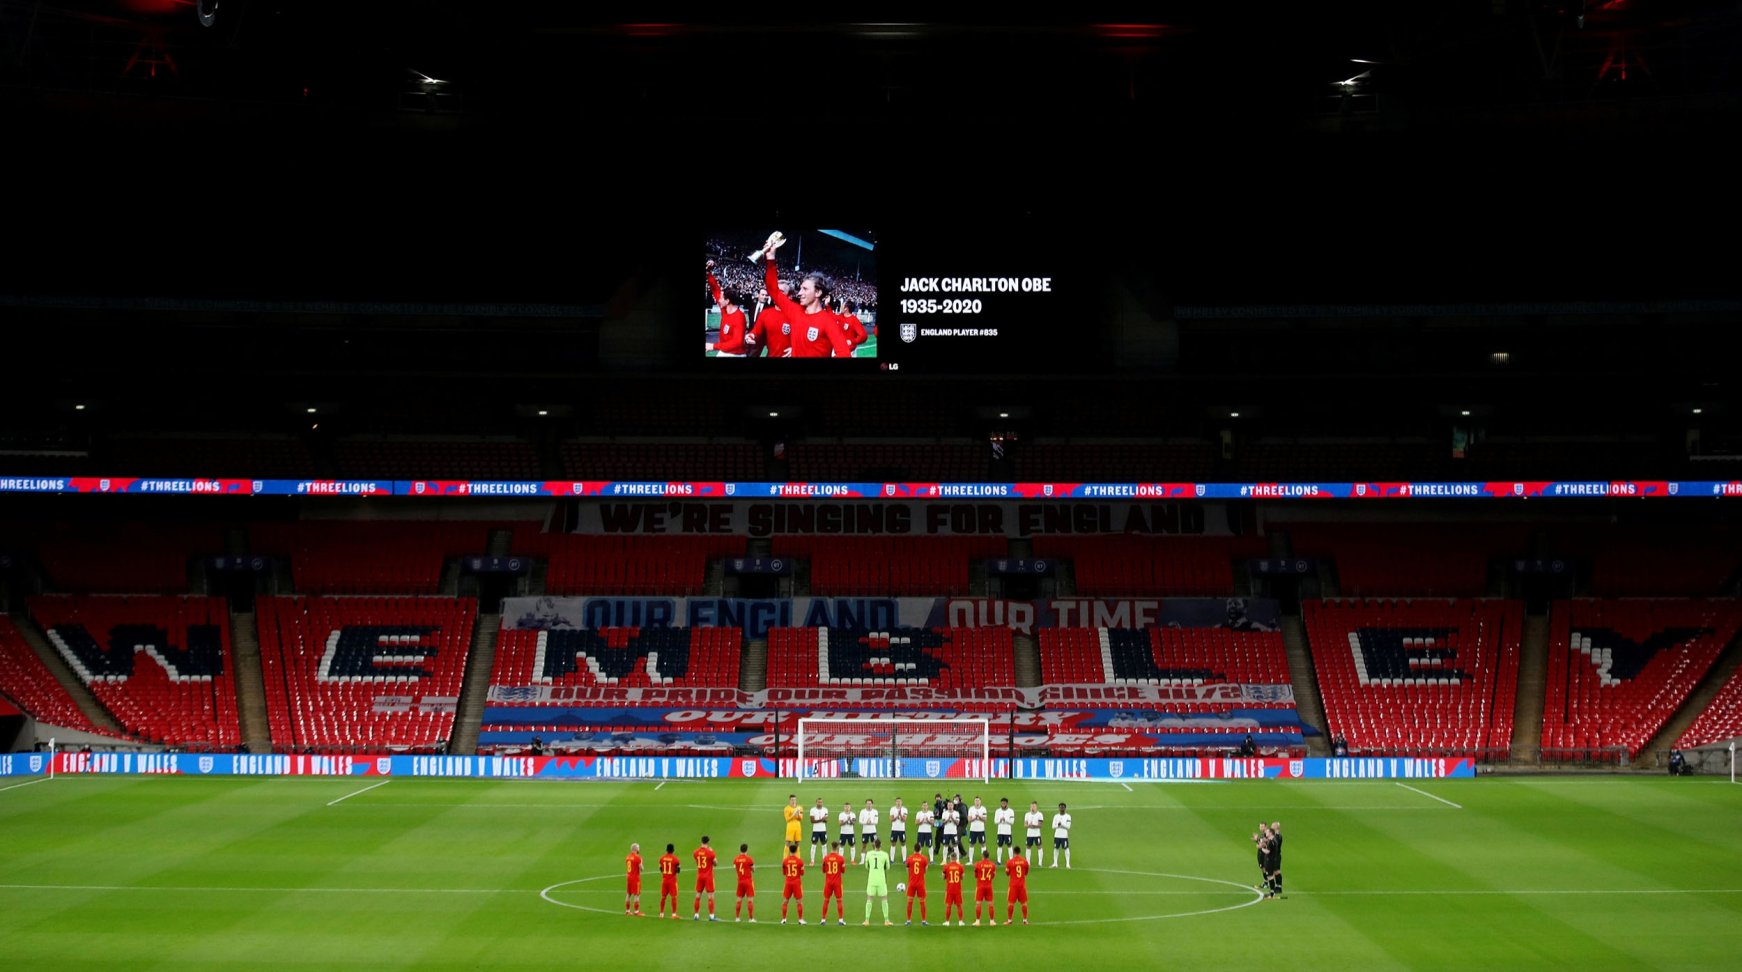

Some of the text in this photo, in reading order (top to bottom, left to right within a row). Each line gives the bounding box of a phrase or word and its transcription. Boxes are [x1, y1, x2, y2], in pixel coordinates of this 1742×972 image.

[900, 278, 1051, 292] JACK CHARLTON OBE
[900, 299, 982, 313] 1935-2020
[141, 481, 220, 492] #THREELIONS
[297, 482, 376, 493] #THREELIONS
[459, 483, 537, 494] #THREELIONS
[614, 484, 692, 495] #THREELIONS
[770, 484, 848, 495] #THREELIONS
[929, 485, 1007, 496] #THREELIONS
[1084, 485, 1162, 496] #THREELIONS
[1240, 485, 1319, 496] #THREELIONS
[1400, 484, 1478, 495] #THREELIONS
[1555, 484, 1635, 495] #THREELIONS
[599, 502, 1205, 537] WE'RE SINGING FOR ENGLAND
[583, 598, 676, 628] OUR
[948, 599, 1036, 635] OUR
[550, 687, 628, 701] OUR
[768, 688, 847, 700] OUR
[124, 754, 131, 773] V
[137, 755, 178, 773] WALES
[232, 755, 353, 775] ENGLAND V WALES
[413, 757, 535, 776] ENGLAND V WALES
[596, 758, 719, 777] ENGLAND V WALES
[1030, 759, 1038, 778] V
[1044, 759, 1087, 778] WALES
[1144, 759, 1265, 778] ENGLAND V WALES
[1326, 759, 1446, 778] ENGLAND V WALES
[663, 862, 672, 874] 11
[697, 856, 707, 868] 13
[827, 862, 838, 874] 18
[874, 857, 879, 869] 1
[913, 862, 920, 874] 6
[739, 863, 744, 875] 4
[787, 864, 798, 876] 15
[981, 868, 991, 880] 14
[1016, 865, 1022, 878] 9
[949, 870, 960, 883] 16
